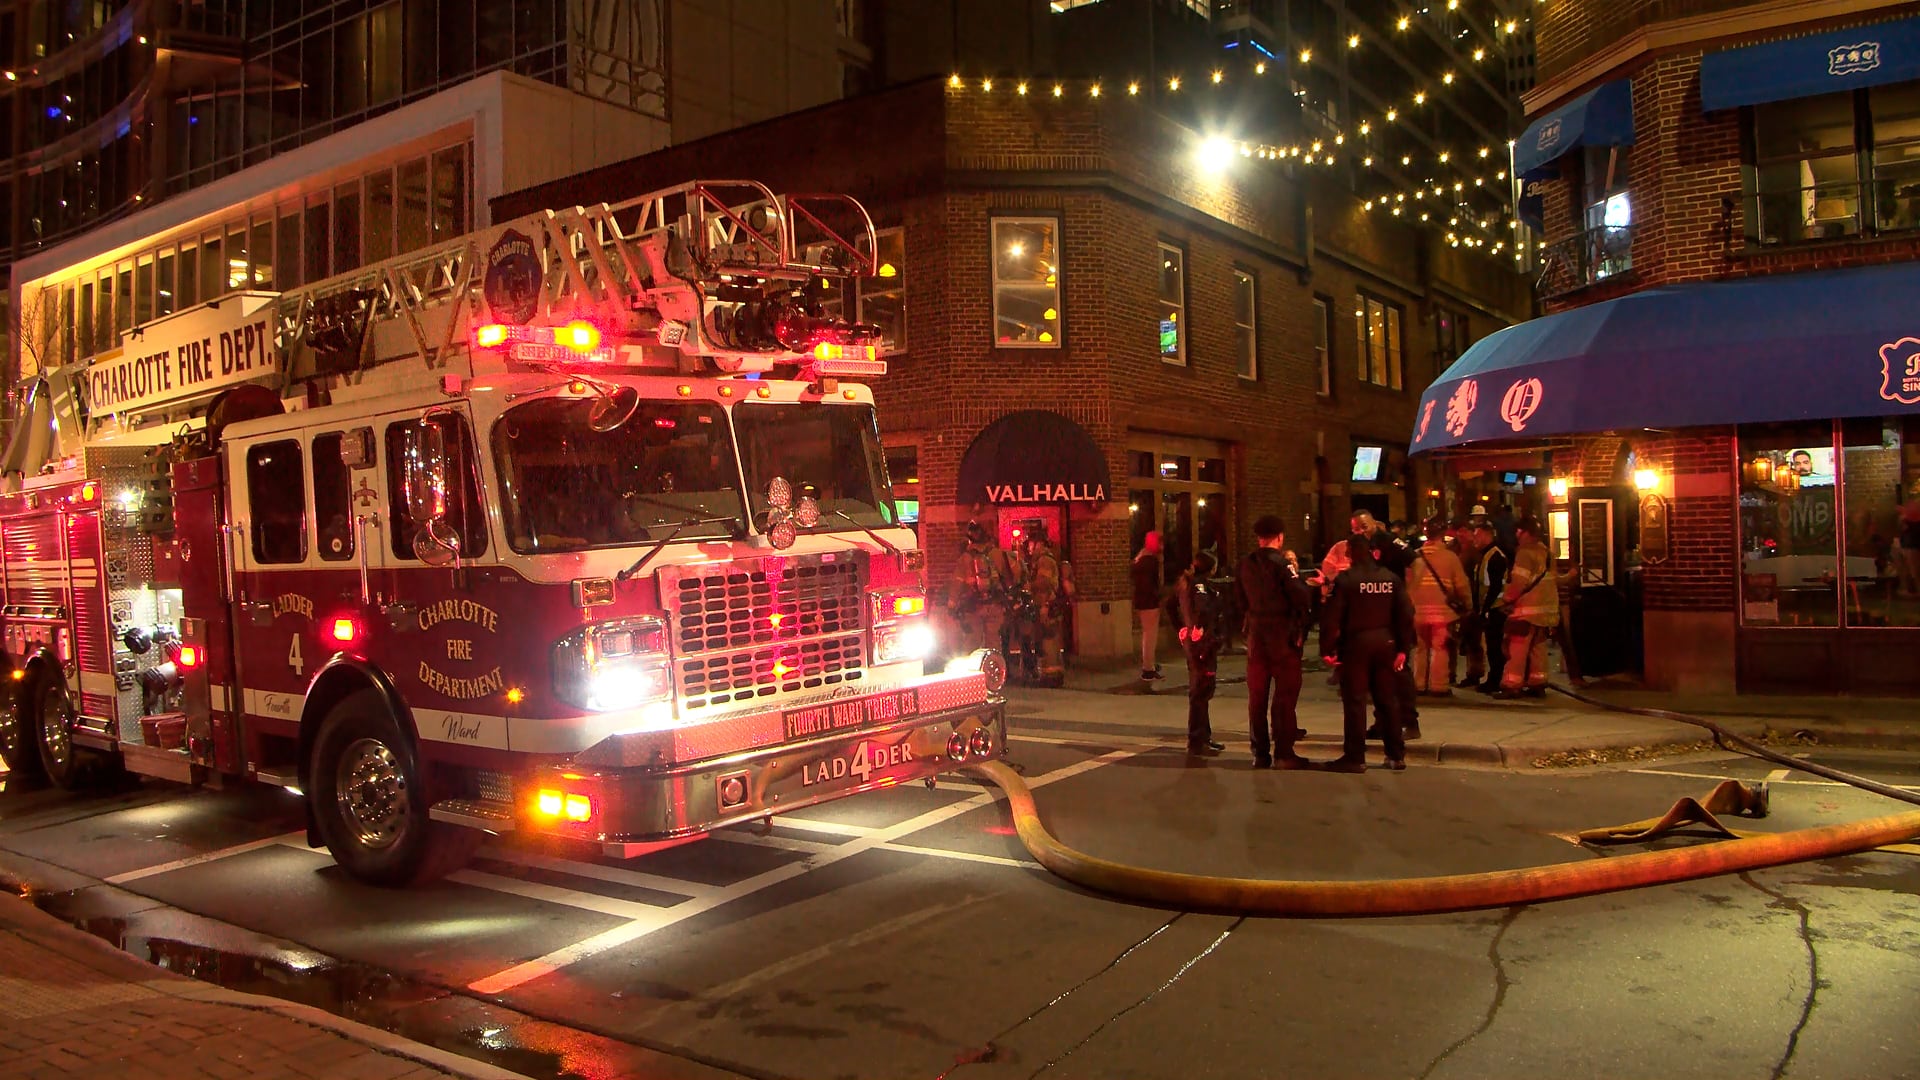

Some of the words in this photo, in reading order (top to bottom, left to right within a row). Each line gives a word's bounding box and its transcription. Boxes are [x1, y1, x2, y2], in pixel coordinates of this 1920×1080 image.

[491, 241, 530, 267] CHARLOTTE
[92, 350, 171, 410] CHARLOTTE
[178, 337, 213, 387] FIRE
[220, 320, 273, 376] DEPT.
[986, 484, 1105, 502] VALHALLA
[1360, 582, 1393, 593] POLICE
[272, 593, 313, 620] LADDER
[418, 599, 498, 633] CHARLOTTE
[288, 633, 304, 675] 4
[447, 639, 473, 660] FIRE
[418, 661, 504, 699] DEPARTMENT
[442, 715, 481, 740] Ward
[786, 707, 830, 737] FOURTH
[832, 701, 863, 728] WARD
[865, 694, 900, 721] TRUCK
[901, 691, 917, 715] CO.
